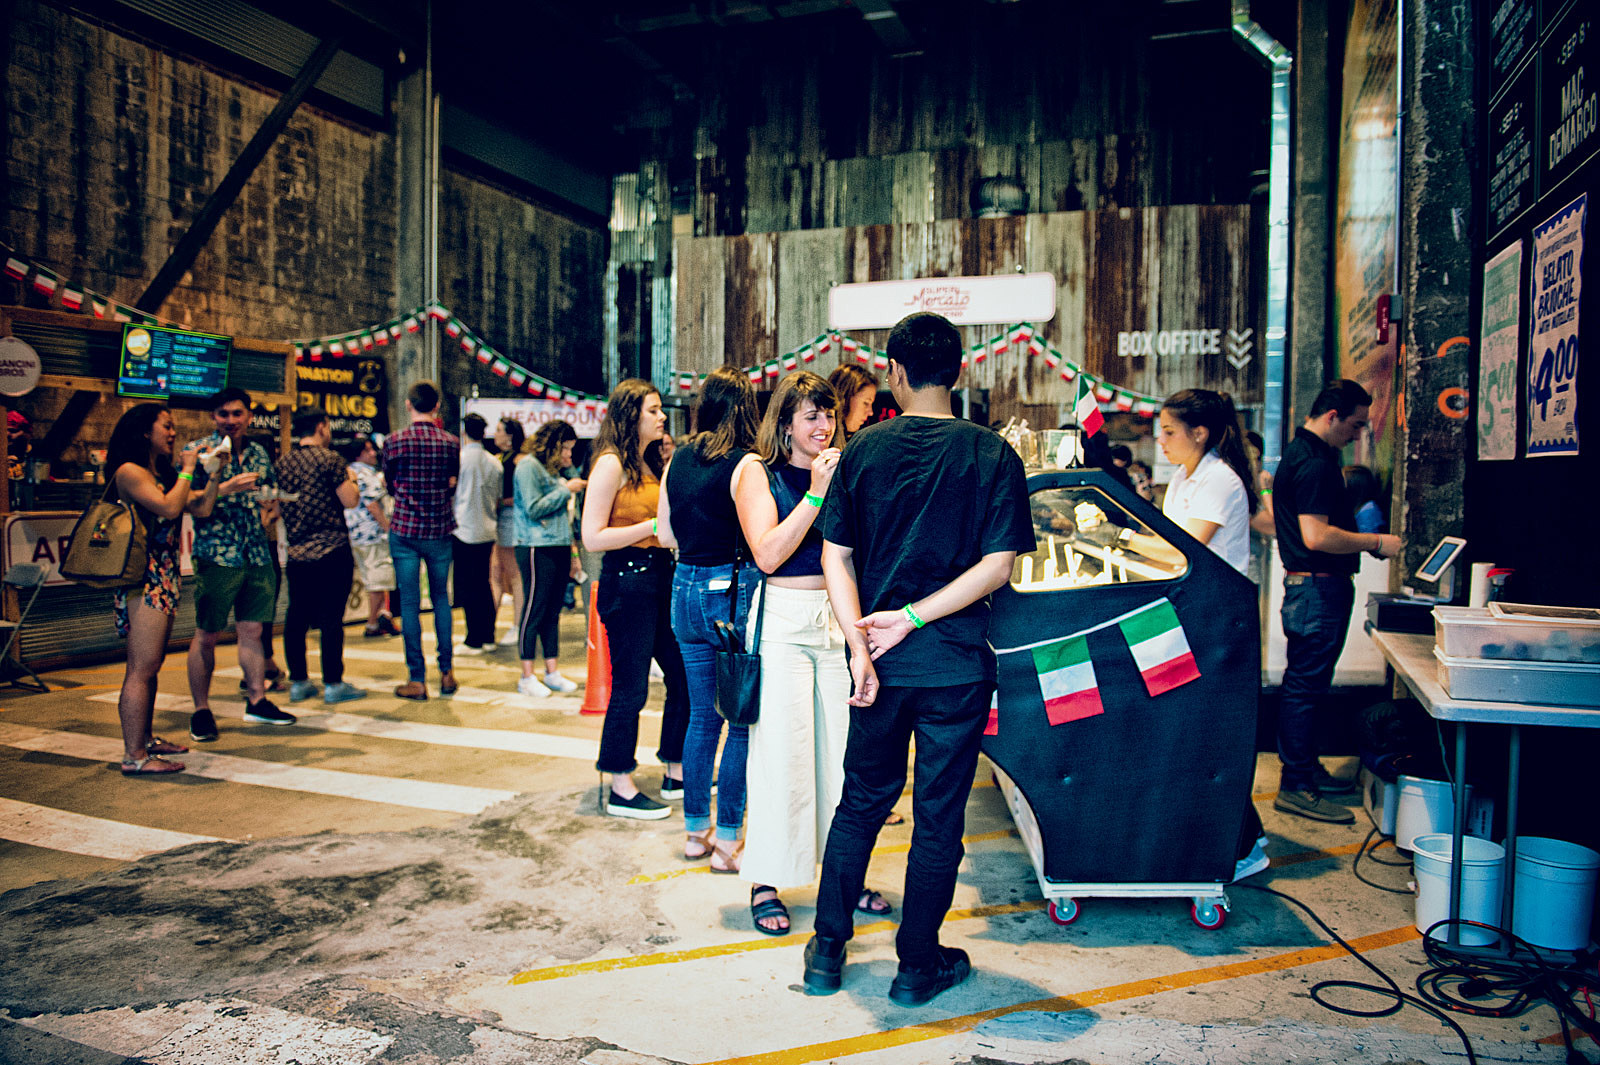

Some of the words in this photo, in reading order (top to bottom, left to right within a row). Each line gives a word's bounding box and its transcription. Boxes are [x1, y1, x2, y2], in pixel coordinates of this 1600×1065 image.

[1561, 65, 1584, 122] MAC
[1549, 91, 1598, 171] DEMARCO
[1542, 249, 1574, 292] GELATO
[0, 359, 36, 368] ANCINI
[1117, 331, 1153, 357] BOX
[1157, 328, 1221, 356] OFFICE
